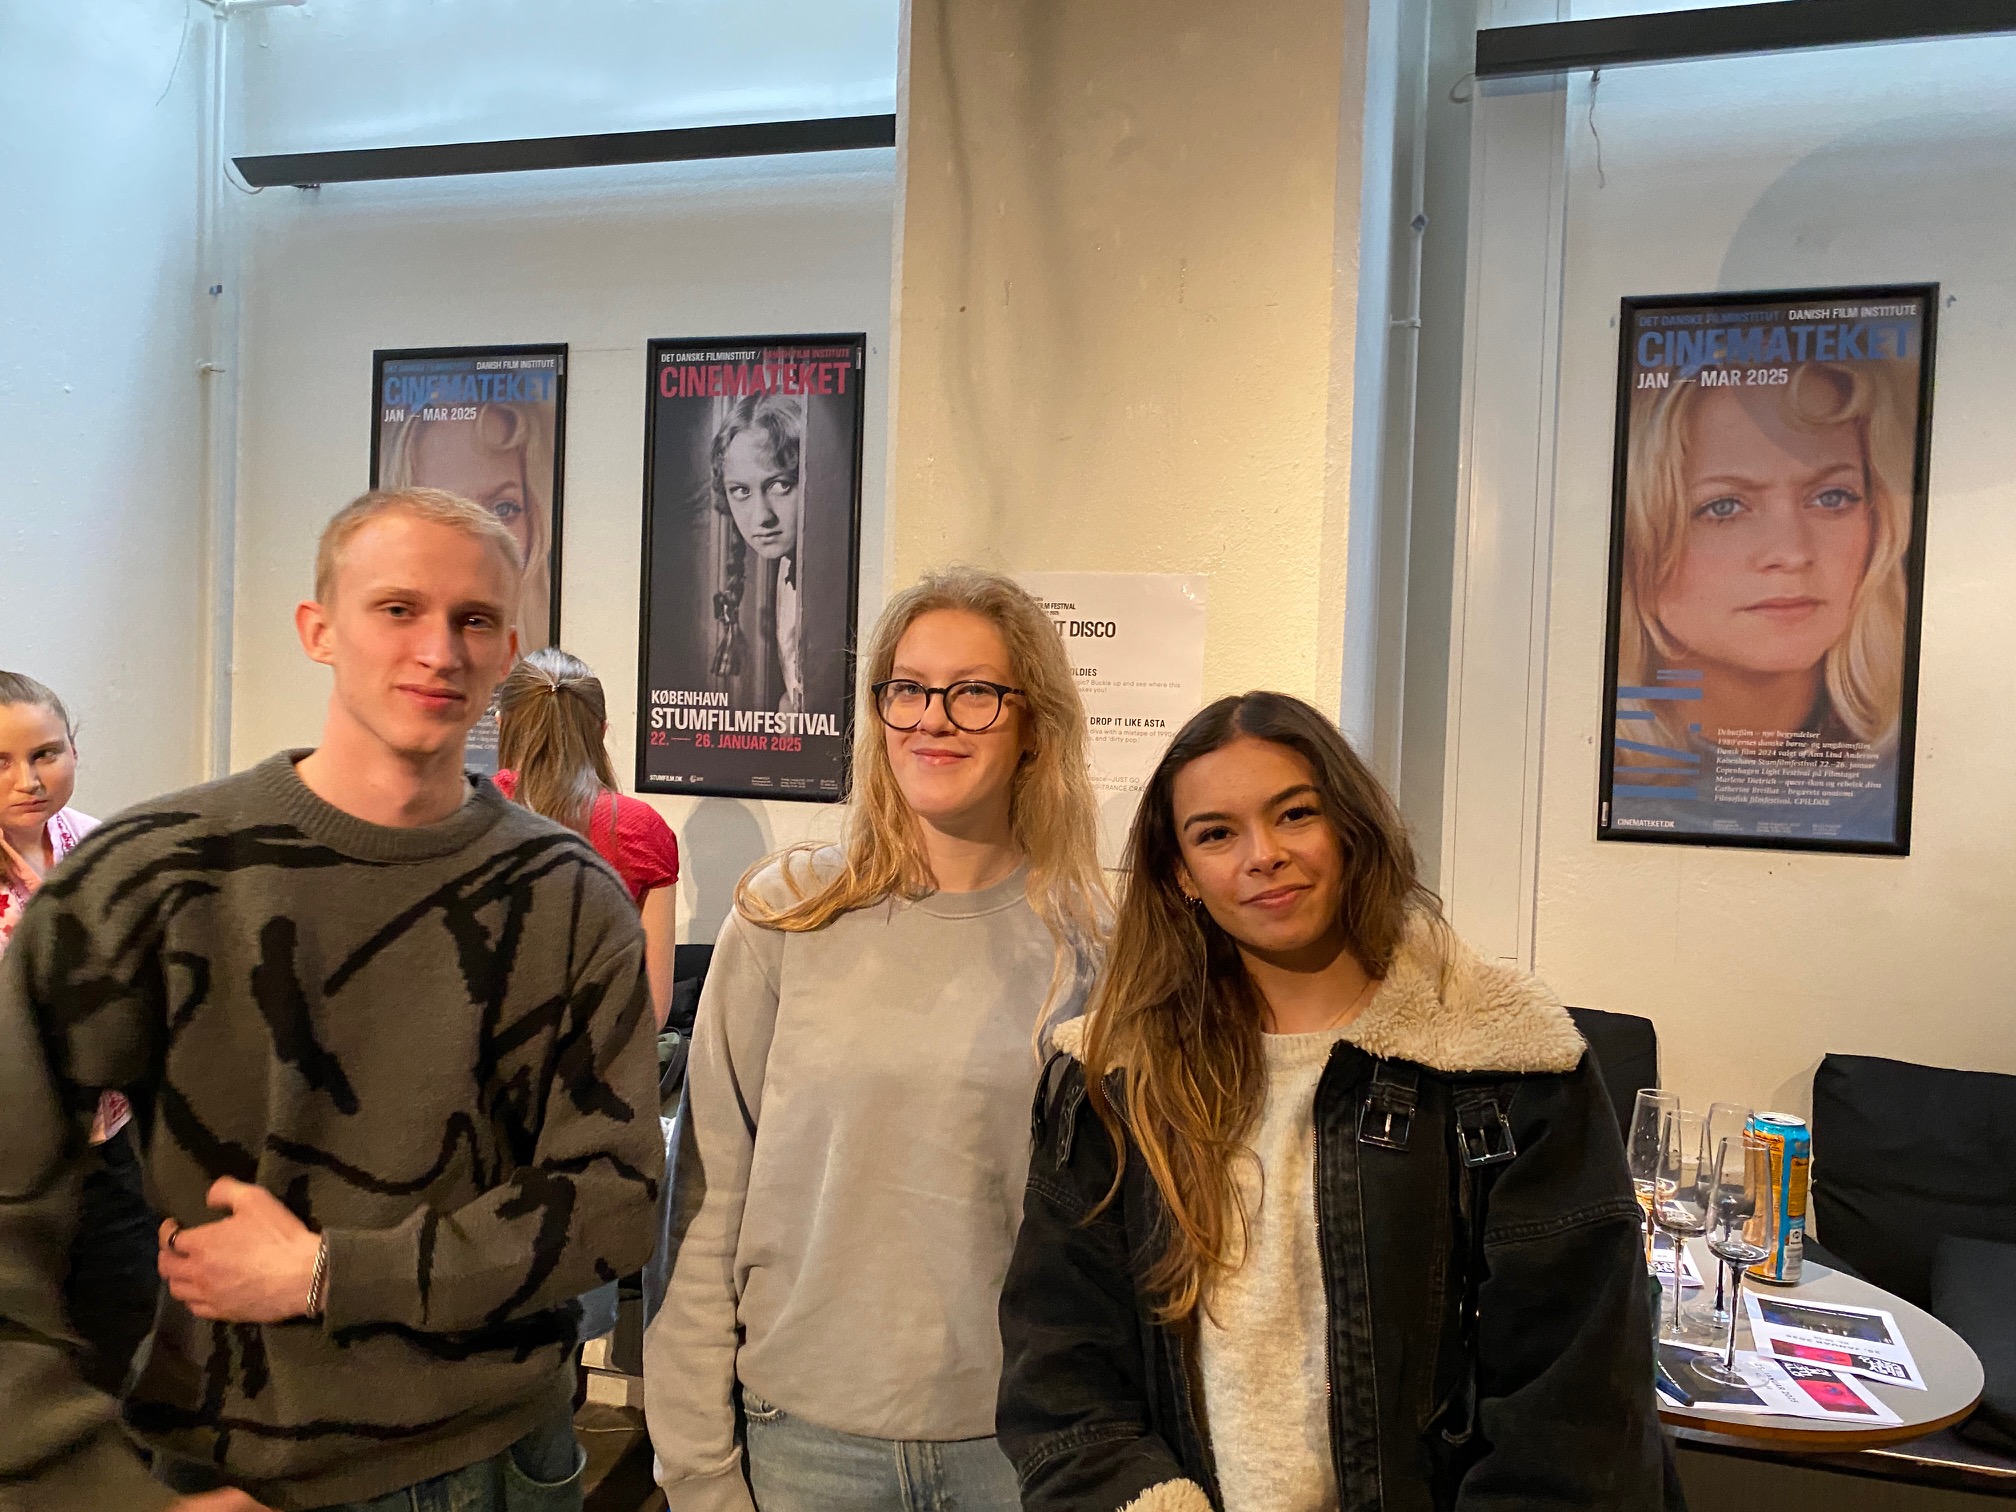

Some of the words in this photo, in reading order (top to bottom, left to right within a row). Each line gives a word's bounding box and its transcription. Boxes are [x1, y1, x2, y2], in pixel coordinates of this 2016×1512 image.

[1788, 309, 1830, 320] DANISH
[1832, 307, 1858, 319] FILM
[1860, 304, 1917, 317] INSTITUTE
[1638, 321, 1912, 368] CINEMATEKET
[476, 361, 501, 371] DANISH
[502, 360, 519, 370] FILM
[519, 359, 555, 370] INSTITUTE
[661, 353, 676, 363] DET
[677, 352, 705, 363] DANSKE
[706, 351, 756, 362] FILMINSTITUT
[660, 362, 851, 398] CINEMATEKET
[1637, 373, 1669, 389] JAN
[1700, 370, 1740, 387] MAR
[1746, 368, 1788, 386] 2025
[384, 373, 554, 406] CINEMATEKET
[384, 409, 404, 423] JAN
[423, 408, 448, 422] MAR
[450, 407, 477, 421] 2025
[1051, 602, 1076, 610] FESTIVAL
[1070, 620, 1116, 638] DISCO
[651, 690, 728, 707] KØBENHAVN
[651, 707, 840, 736] STUMFILMFESTIVAL
[1090, 717, 1113, 726] DROP
[1114, 717, 1122, 726] IT
[1124, 718, 1142, 727] LIKE
[1144, 719, 1165, 728] ASTA
[650, 731, 670, 746] 22.
[695, 733, 715, 748] 26.
[717, 735, 768, 750] JANUAR
[770, 737, 802, 751] 2025
[1617, 817, 1676, 828] CINEMATEKET.DK
